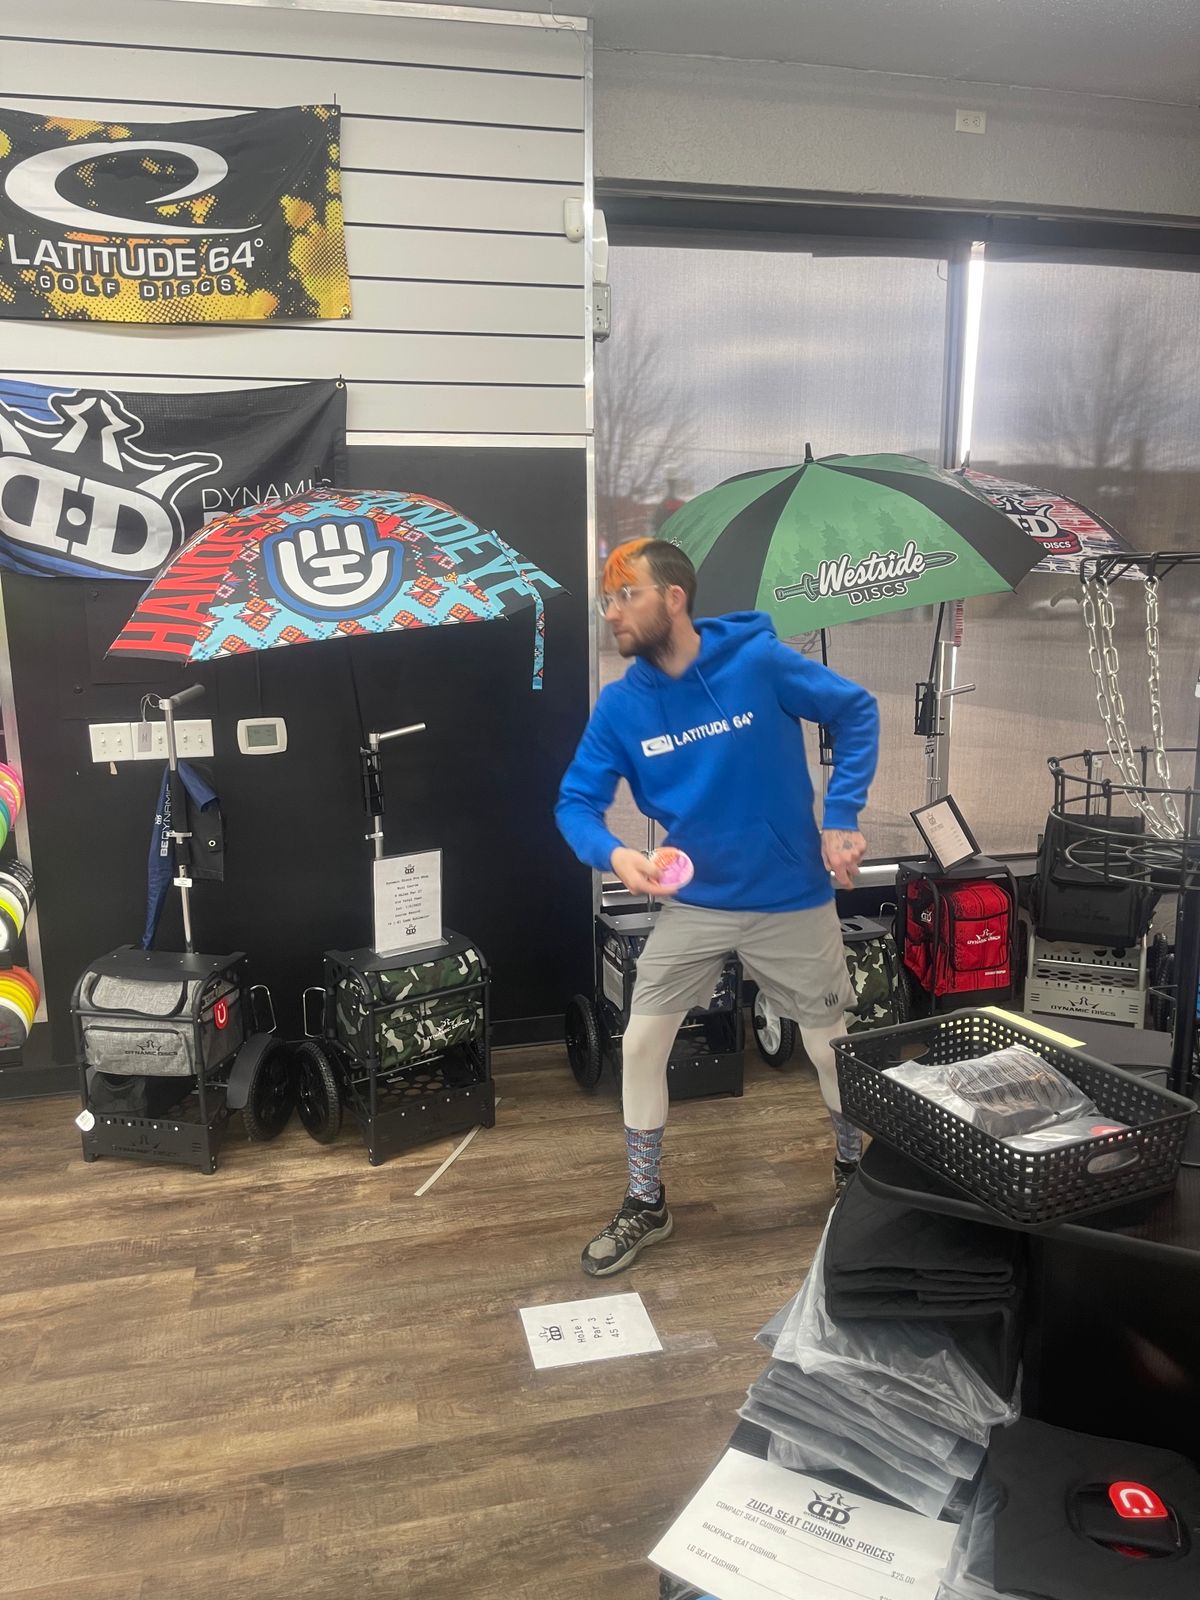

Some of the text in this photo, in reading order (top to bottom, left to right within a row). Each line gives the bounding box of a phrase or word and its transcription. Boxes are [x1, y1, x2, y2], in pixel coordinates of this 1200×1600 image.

[8, 234, 197, 277] LATITUDE
[39, 275, 232, 298] GOLF DISCS
[201, 478, 332, 510] DYNAMI
[1043, 541, 1072, 549] DISCS
[819, 541, 926, 595] Westside
[850, 582, 906, 603] DISCS
[673, 720, 731, 746] LATITUDE
[1050, 1004, 1090, 1013] DYNAMIC
[573, 1325, 587, 1344] Hole
[593, 1326, 602, 1339] Par
[610, 1328, 620, 1338] 45
[702, 1521, 778, 1561] BACKPACK SEAT CUSHION
[715, 1500, 916, 1585] COMPACT SEAT CUSHION $25.00
[746, 1498, 895, 1562] ZUCA SEAT CUSHIONS PRICES
[686, 1543, 740, 1574] LG SEAT CUSHION
